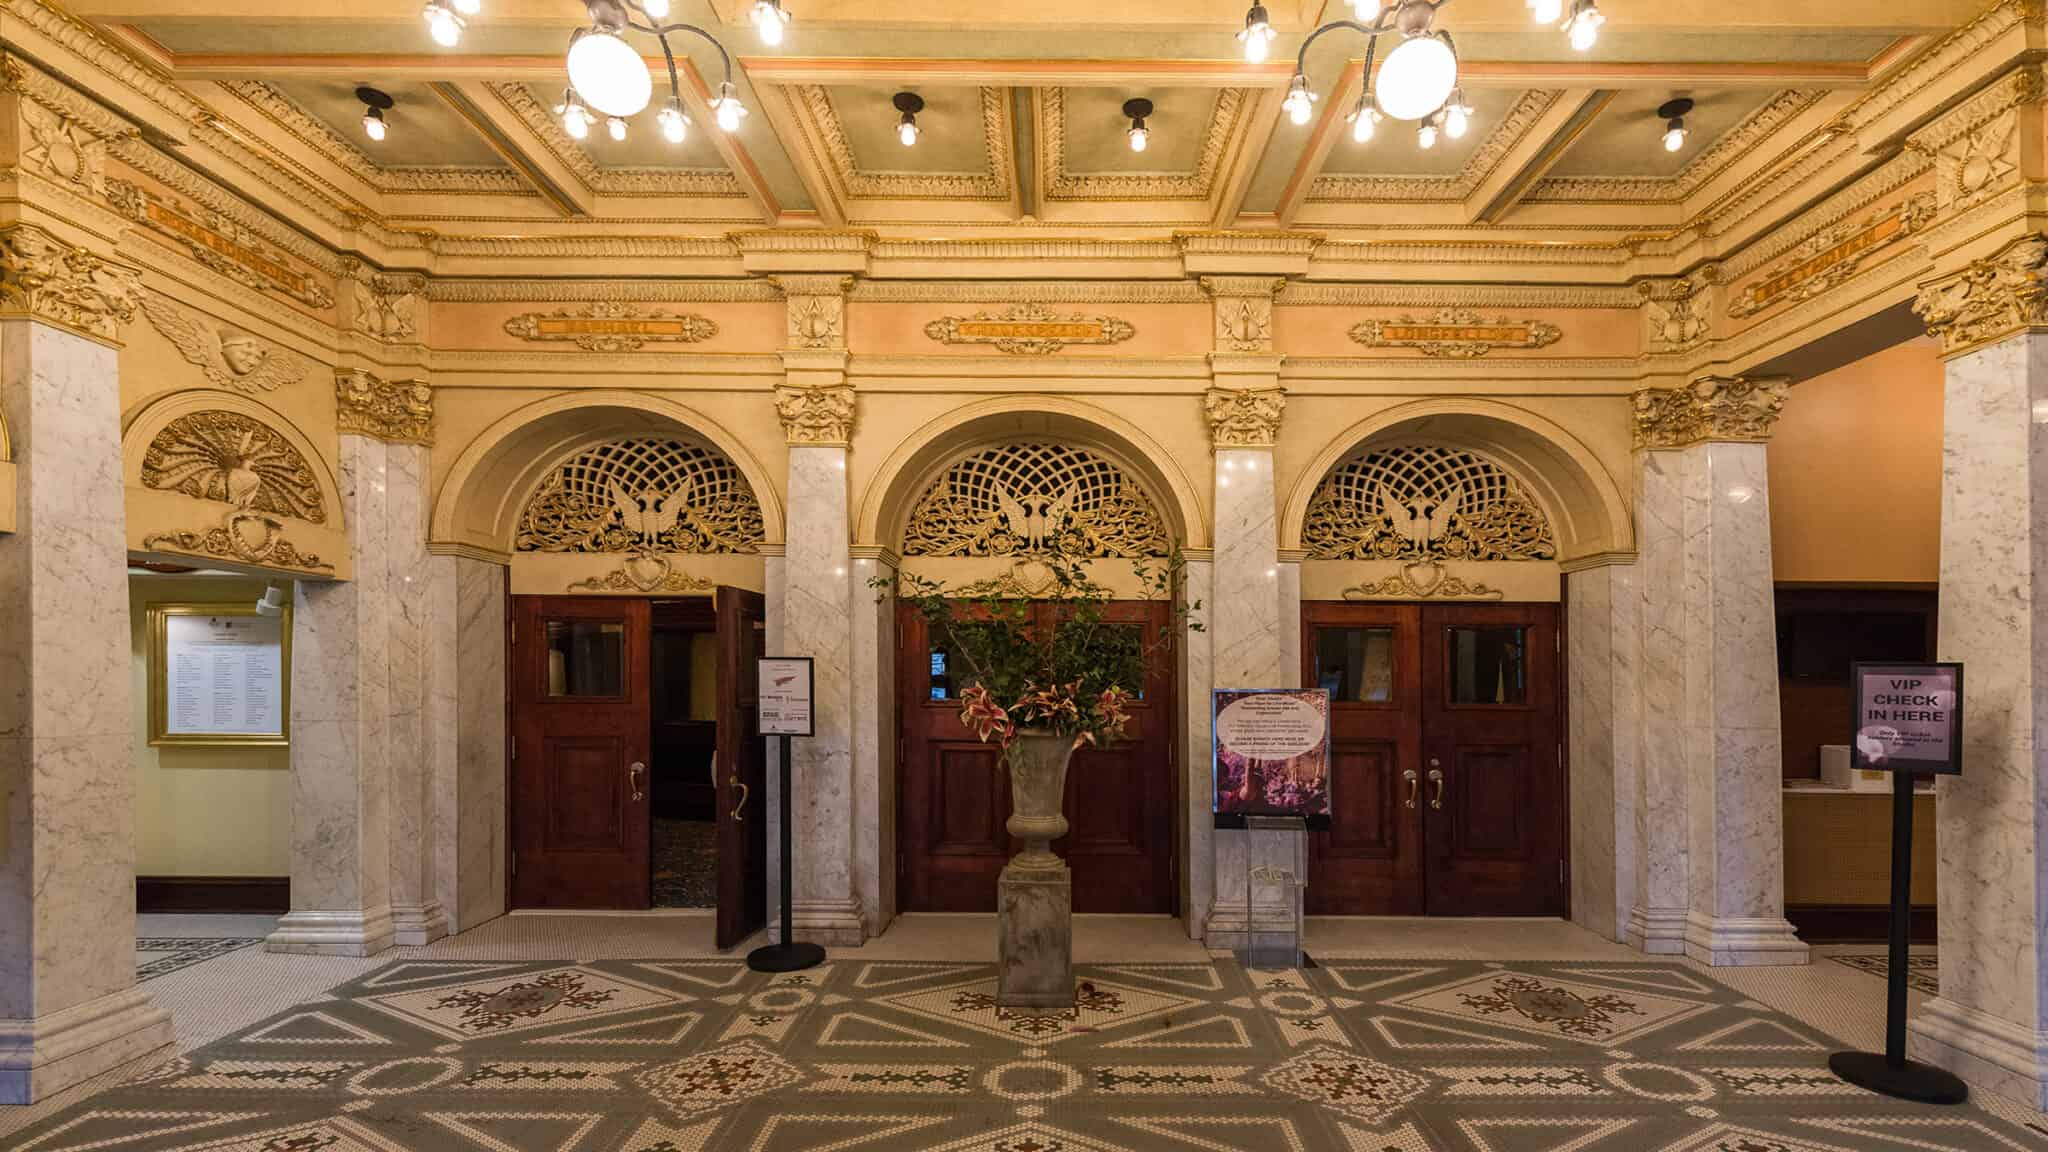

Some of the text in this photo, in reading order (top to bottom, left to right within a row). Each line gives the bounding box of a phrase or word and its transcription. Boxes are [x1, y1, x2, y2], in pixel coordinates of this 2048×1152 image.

[1889, 679, 1922, 690] VIP
[1873, 694, 1938, 706] CHECK
[1868, 709, 1945, 722] IN HERE
